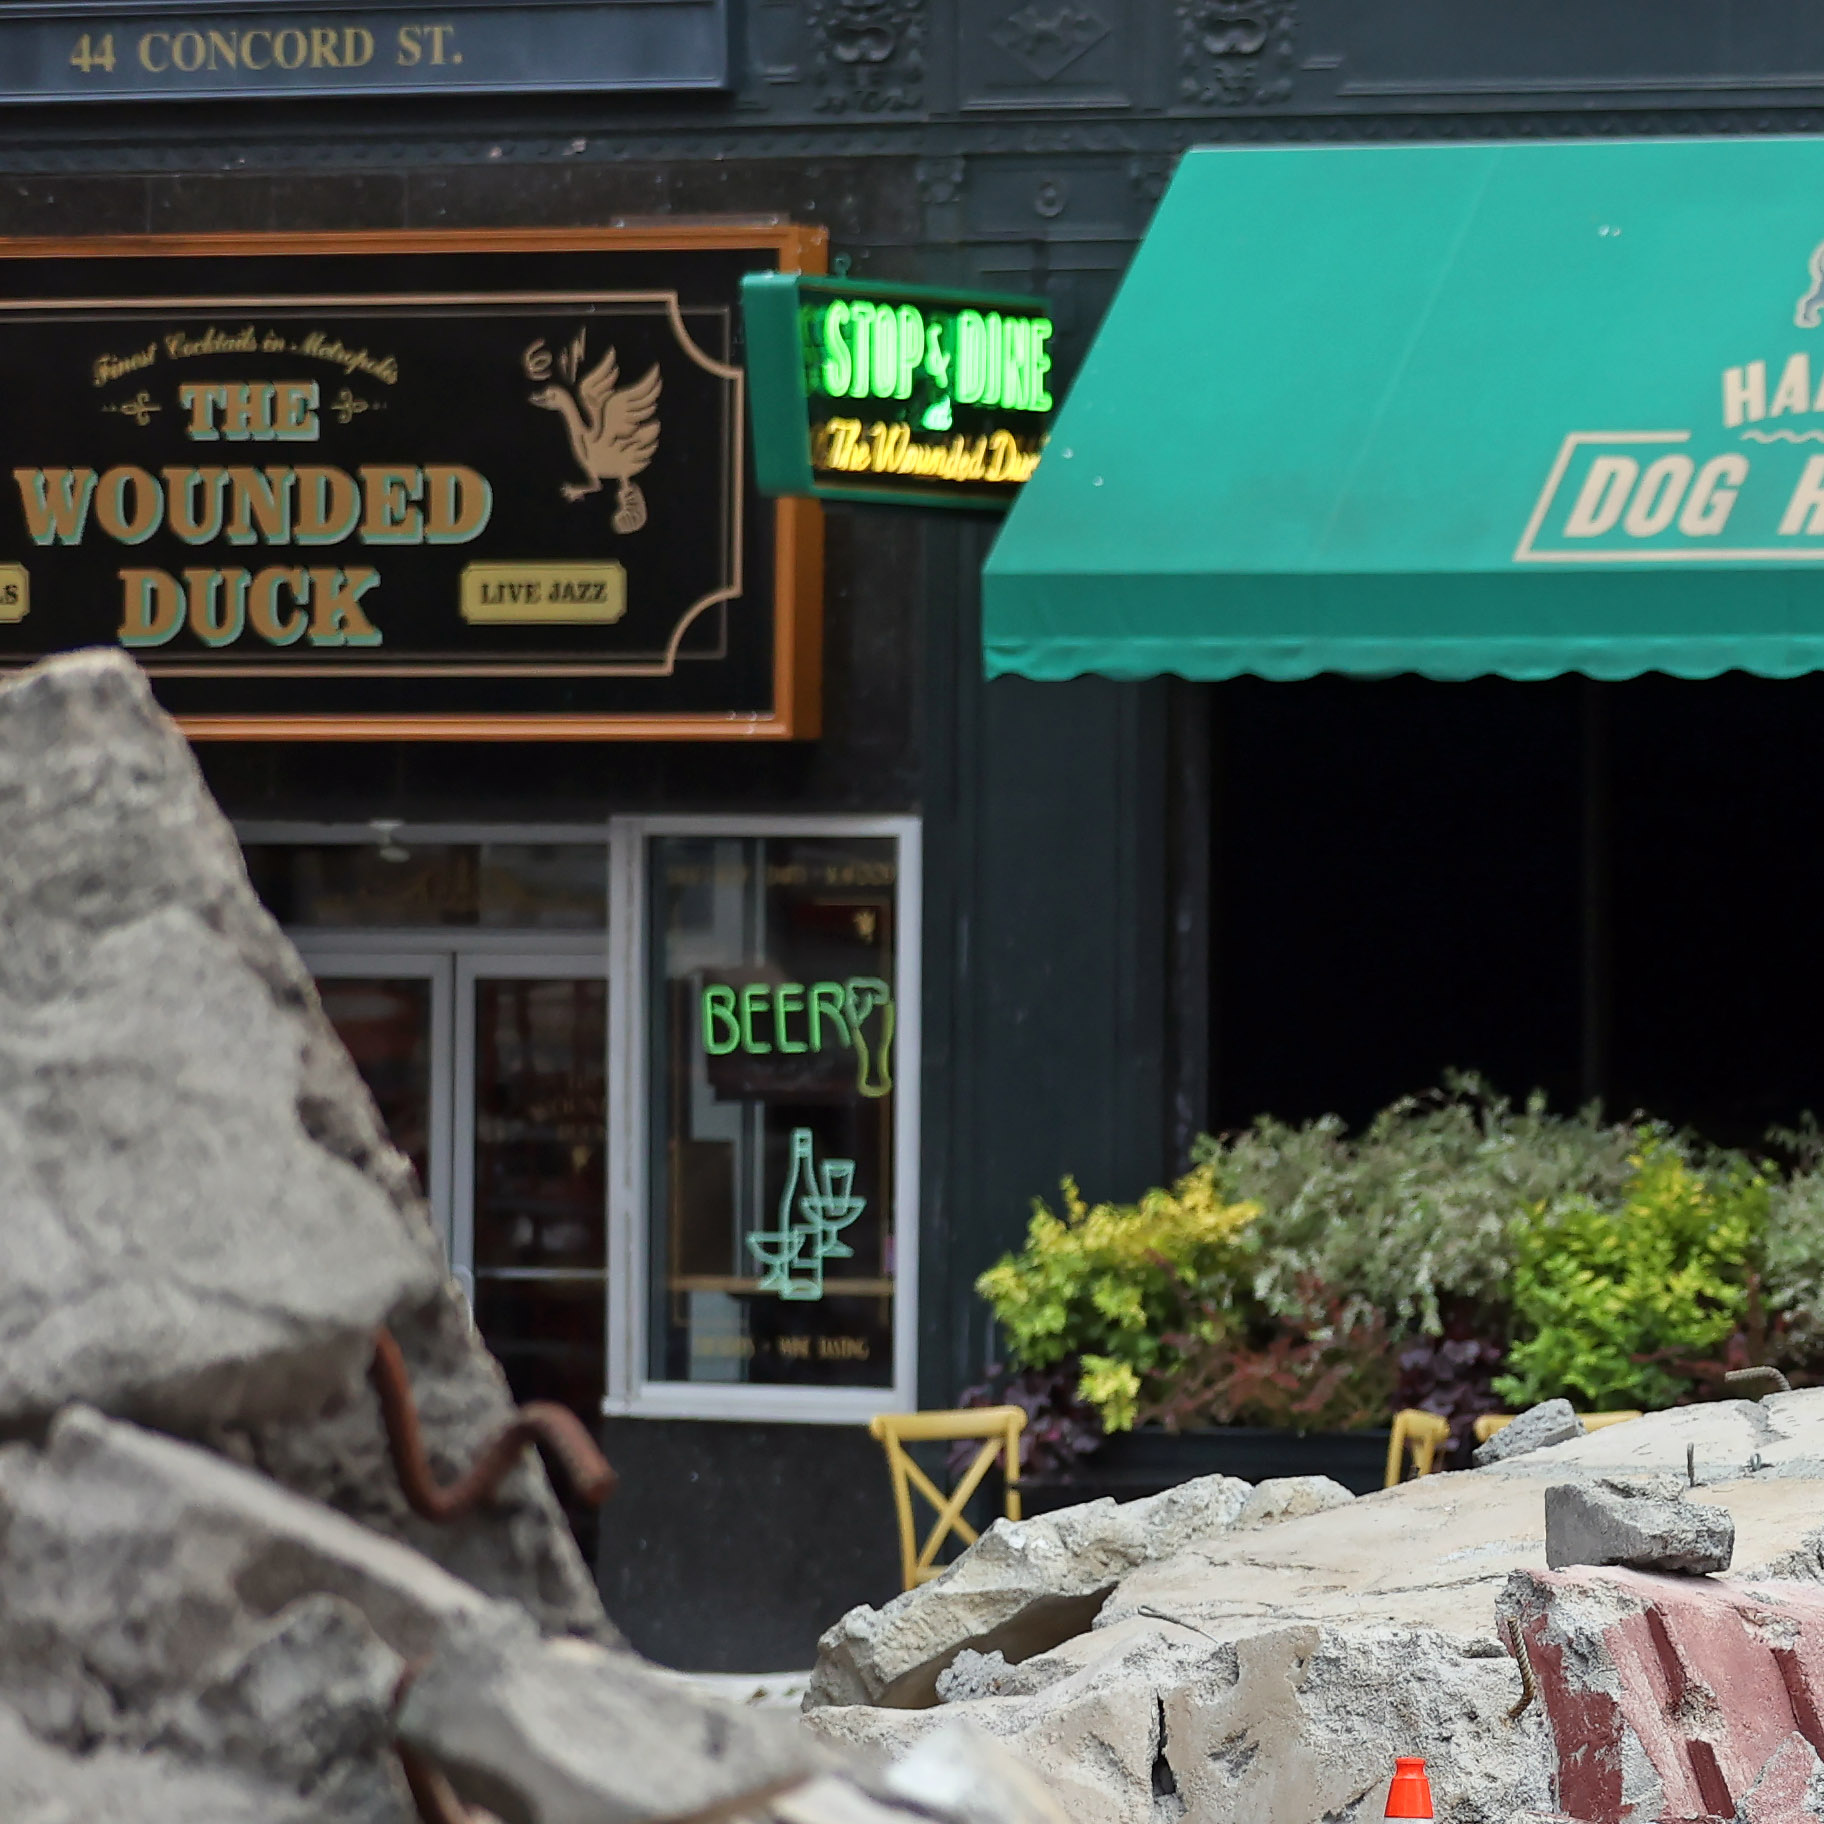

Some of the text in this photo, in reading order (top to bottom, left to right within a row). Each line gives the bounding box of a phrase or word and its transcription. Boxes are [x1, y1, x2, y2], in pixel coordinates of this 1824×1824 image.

[69, 24, 463, 73] 44 CONCORD ST.
[93, 326, 399, 387] Finest Cocktails in Metropolis
[821, 299, 1052, 412] STOP & DINE
[178, 379, 321, 442] THE
[826, 417, 871, 471] The
[868, 420, 988, 482] Wounded
[12, 464, 494, 546] WOUNDED
[1562, 453, 1751, 538] DOG
[117, 565, 384, 648] DUCK
[480, 580, 609, 605] LIVE JAZZ
[702, 980, 853, 1056] BEER
